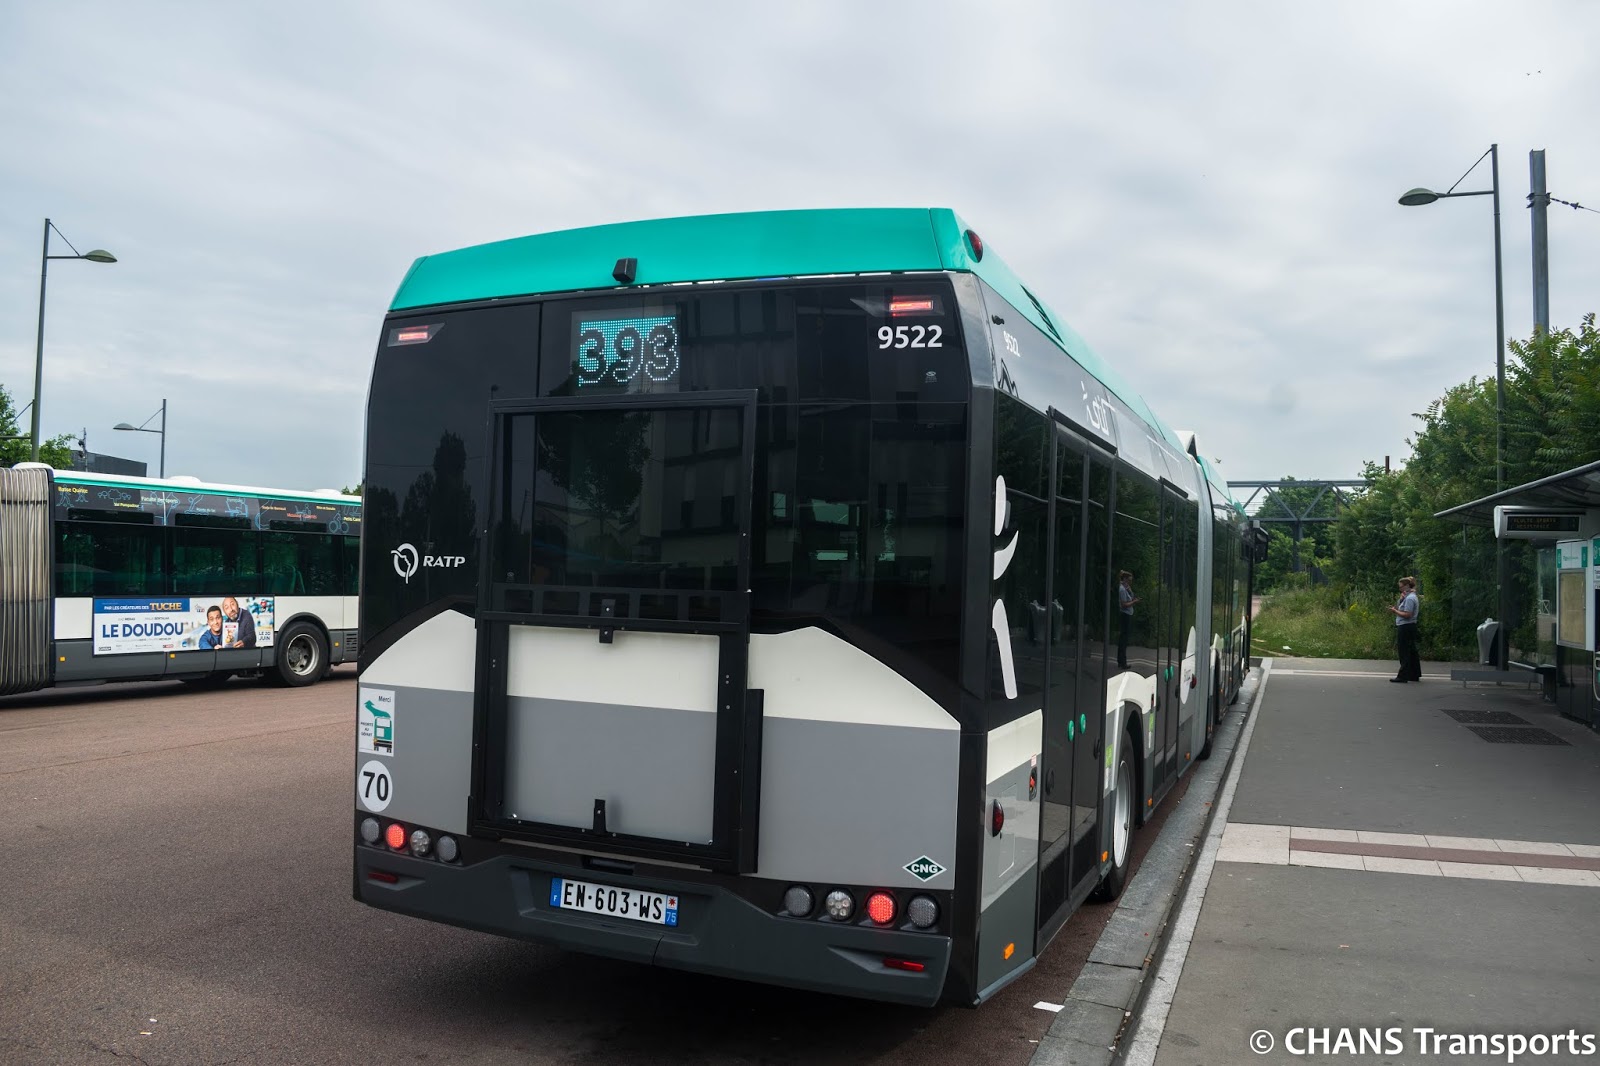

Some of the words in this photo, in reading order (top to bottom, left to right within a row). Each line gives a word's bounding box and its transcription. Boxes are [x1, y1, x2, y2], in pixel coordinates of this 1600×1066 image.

[877, 324, 943, 350] 9522
[578, 320, 680, 387] 393
[423, 555, 466, 568] RATP
[149, 602, 183, 611] TUCHE
[102, 624, 119, 638] LE
[122, 622, 184, 638] DOUDOU
[378, 695, 392, 703] Merci
[363, 770, 389, 802] 70
[910, 863, 939, 874] CNG
[666, 911, 677, 923] 75
